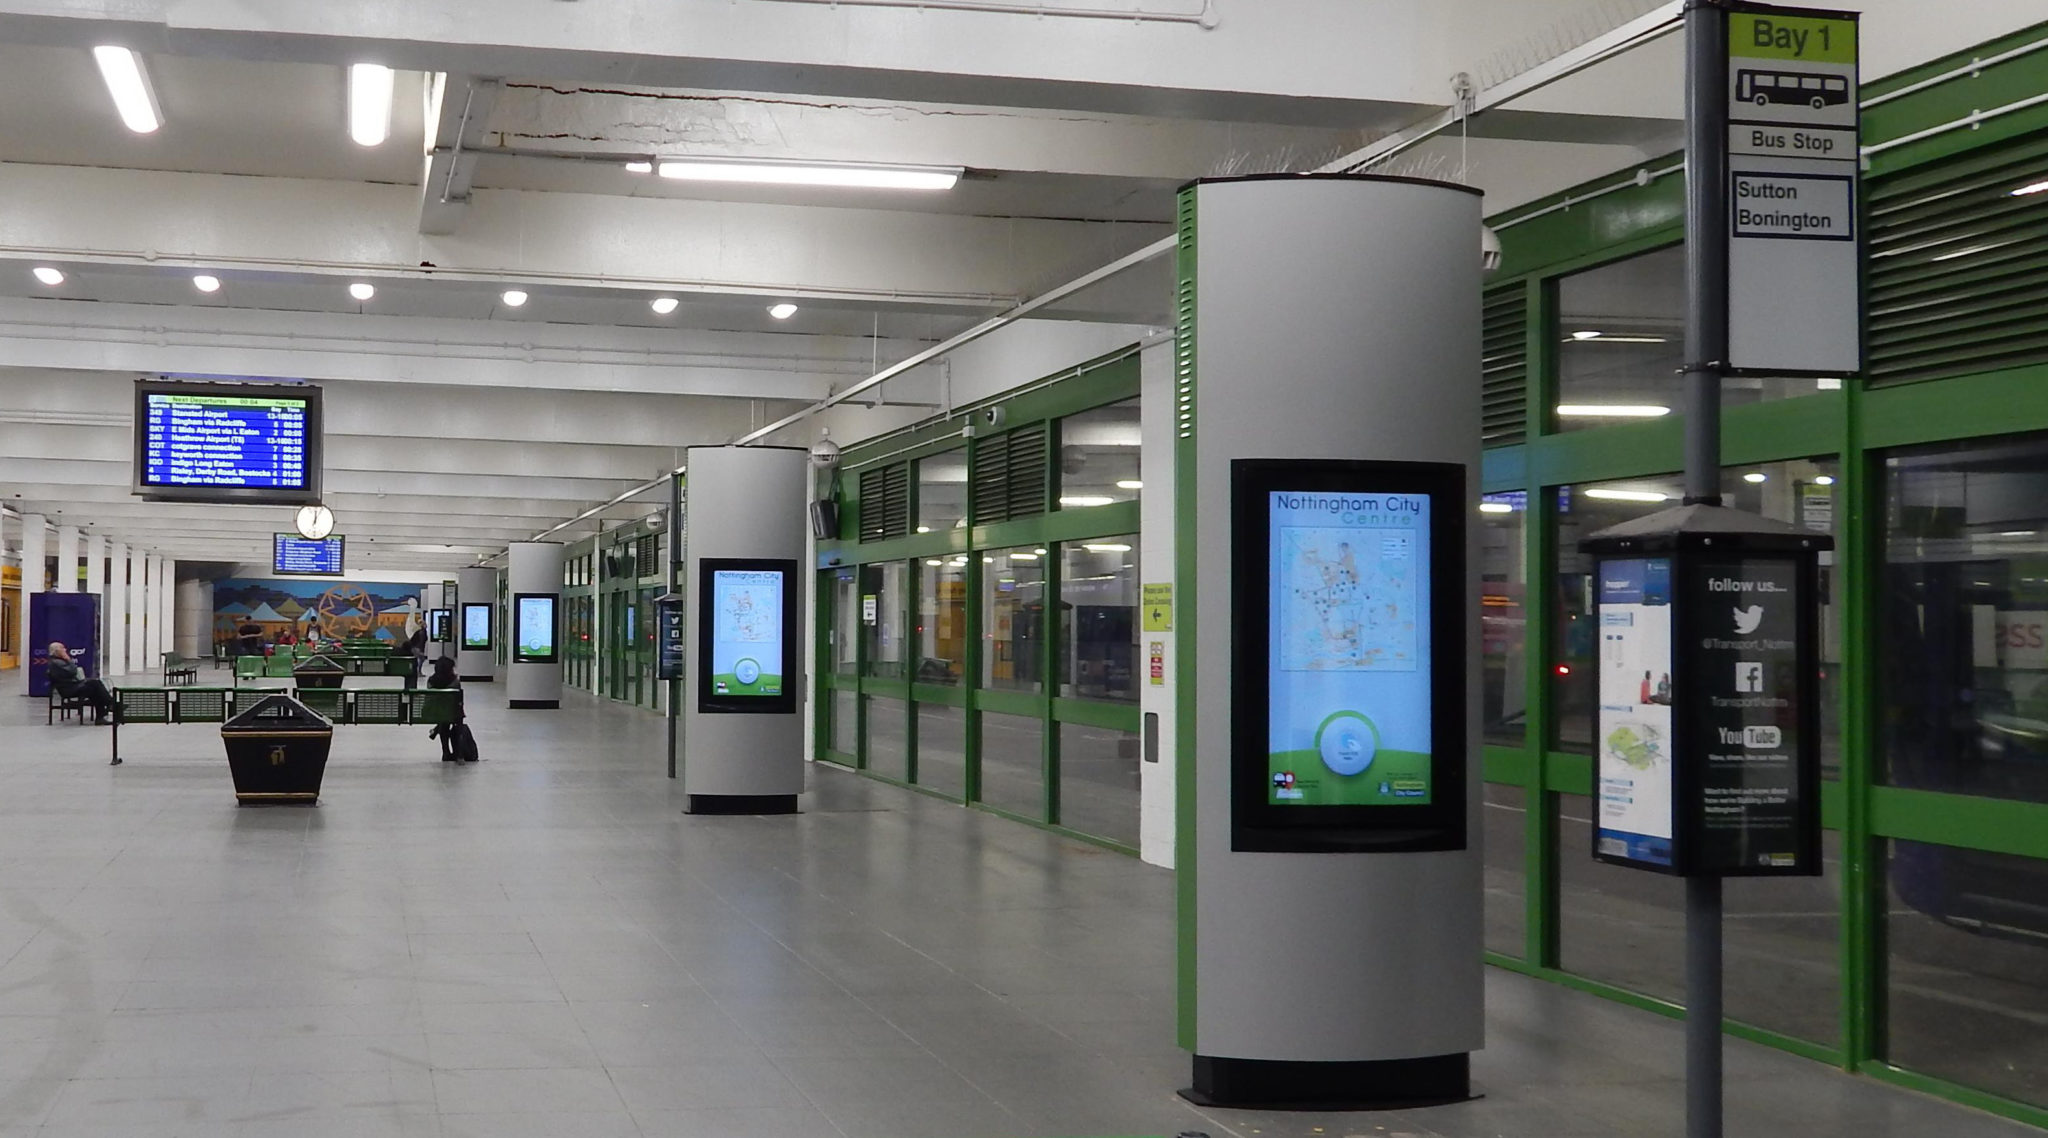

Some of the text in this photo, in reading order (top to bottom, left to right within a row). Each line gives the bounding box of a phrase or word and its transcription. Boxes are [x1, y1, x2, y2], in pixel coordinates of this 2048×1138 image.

[1754, 19, 1830, 57] Bay 1
[1752, 131, 1833, 154] Bus Stop
[1738, 181, 1797, 200] Sutton
[1739, 209, 1831, 232] Bonington
[1278, 495, 1420, 515] Nottingham City
[1341, 512, 1411, 525] Centre
[719, 572, 779, 580] Nottingham City
[1708, 578, 1754, 591] follow
